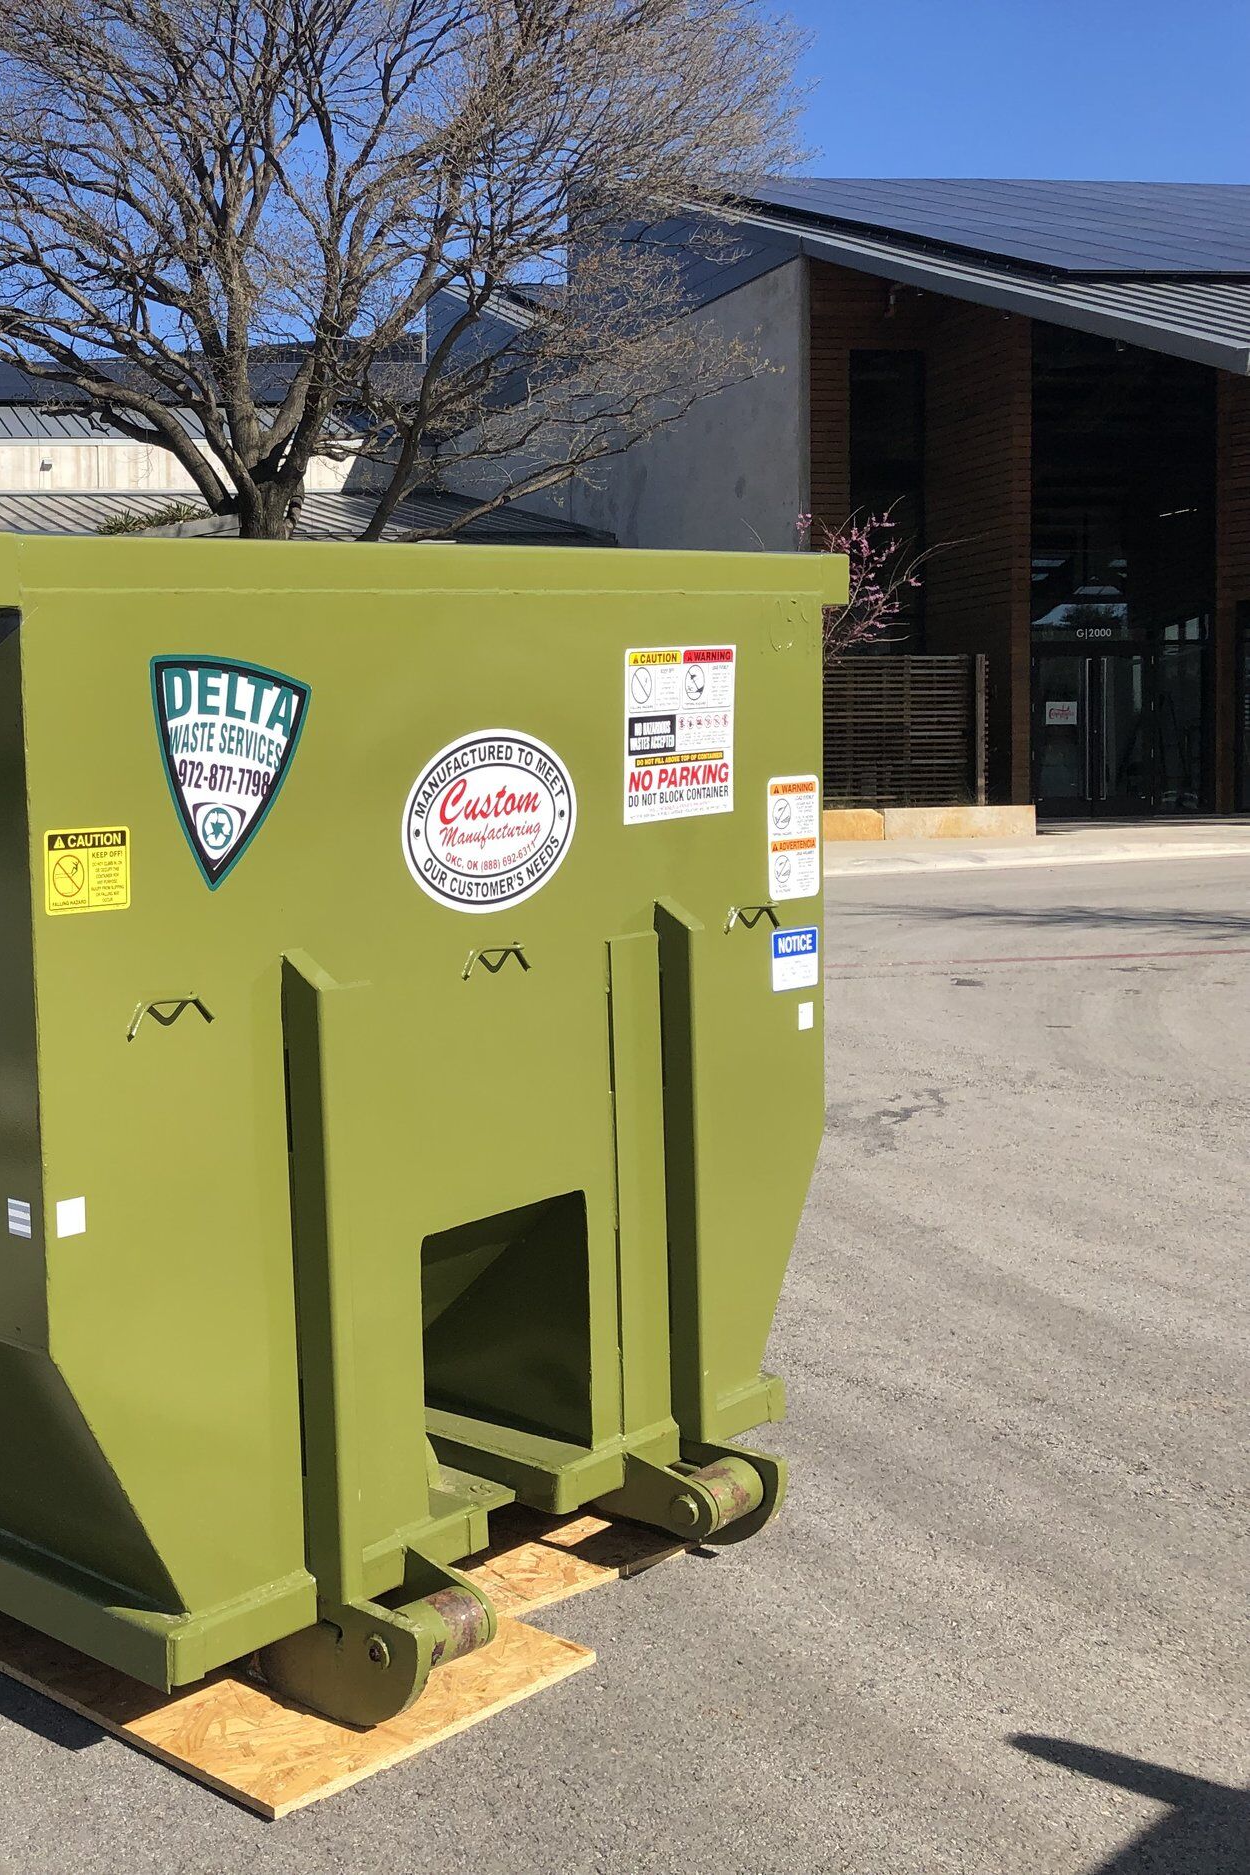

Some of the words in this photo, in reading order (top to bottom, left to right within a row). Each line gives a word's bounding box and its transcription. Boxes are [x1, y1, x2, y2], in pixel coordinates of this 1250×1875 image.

[639, 652, 678, 664] CAUTION
[693, 651, 731, 662] WARNING
[163, 667, 294, 741] DELTA
[169, 721, 216, 756] WASTE
[218, 722, 283, 773] SERVICES
[644, 758, 654, 766] NOT
[665, 755, 680, 763] ABOVE
[680, 754, 690, 762] TOP
[690, 753, 697, 761] OF
[697, 751, 723, 760] CONTAINER
[178, 758, 271, 798] 972-877-7798
[414, 744, 513, 820] MANUFACTURED
[517, 747, 534, 767] TO
[534, 757, 565, 798] MEET
[628, 769, 653, 793] NO
[657, 762, 729, 790] PARKING
[781, 782, 814, 794] WARNING
[439, 778, 542, 825] Custom
[628, 794, 639, 808] DO
[641, 792, 657, 807] NOT
[659, 789, 685, 804] BLOCK
[686, 785, 729, 801] CONTAINER
[67, 832, 122, 848] CAUTION
[439, 820, 541, 850] Manufacturing
[779, 839, 816, 851] ADVERTENCIA
[91, 851, 108, 859] KEEP
[109, 850, 123, 858] OFF!
[423, 857, 448, 888] OUR
[449, 871, 524, 898] CUSTOMER'S
[525, 835, 560, 881] NEEDS
[445, 852, 465, 869] OKC,
[466, 859, 478, 871] OK
[480, 859, 501, 873] (888)
[502, 840, 536, 867] 692-6311
[777, 933, 813, 954] NOTICE
